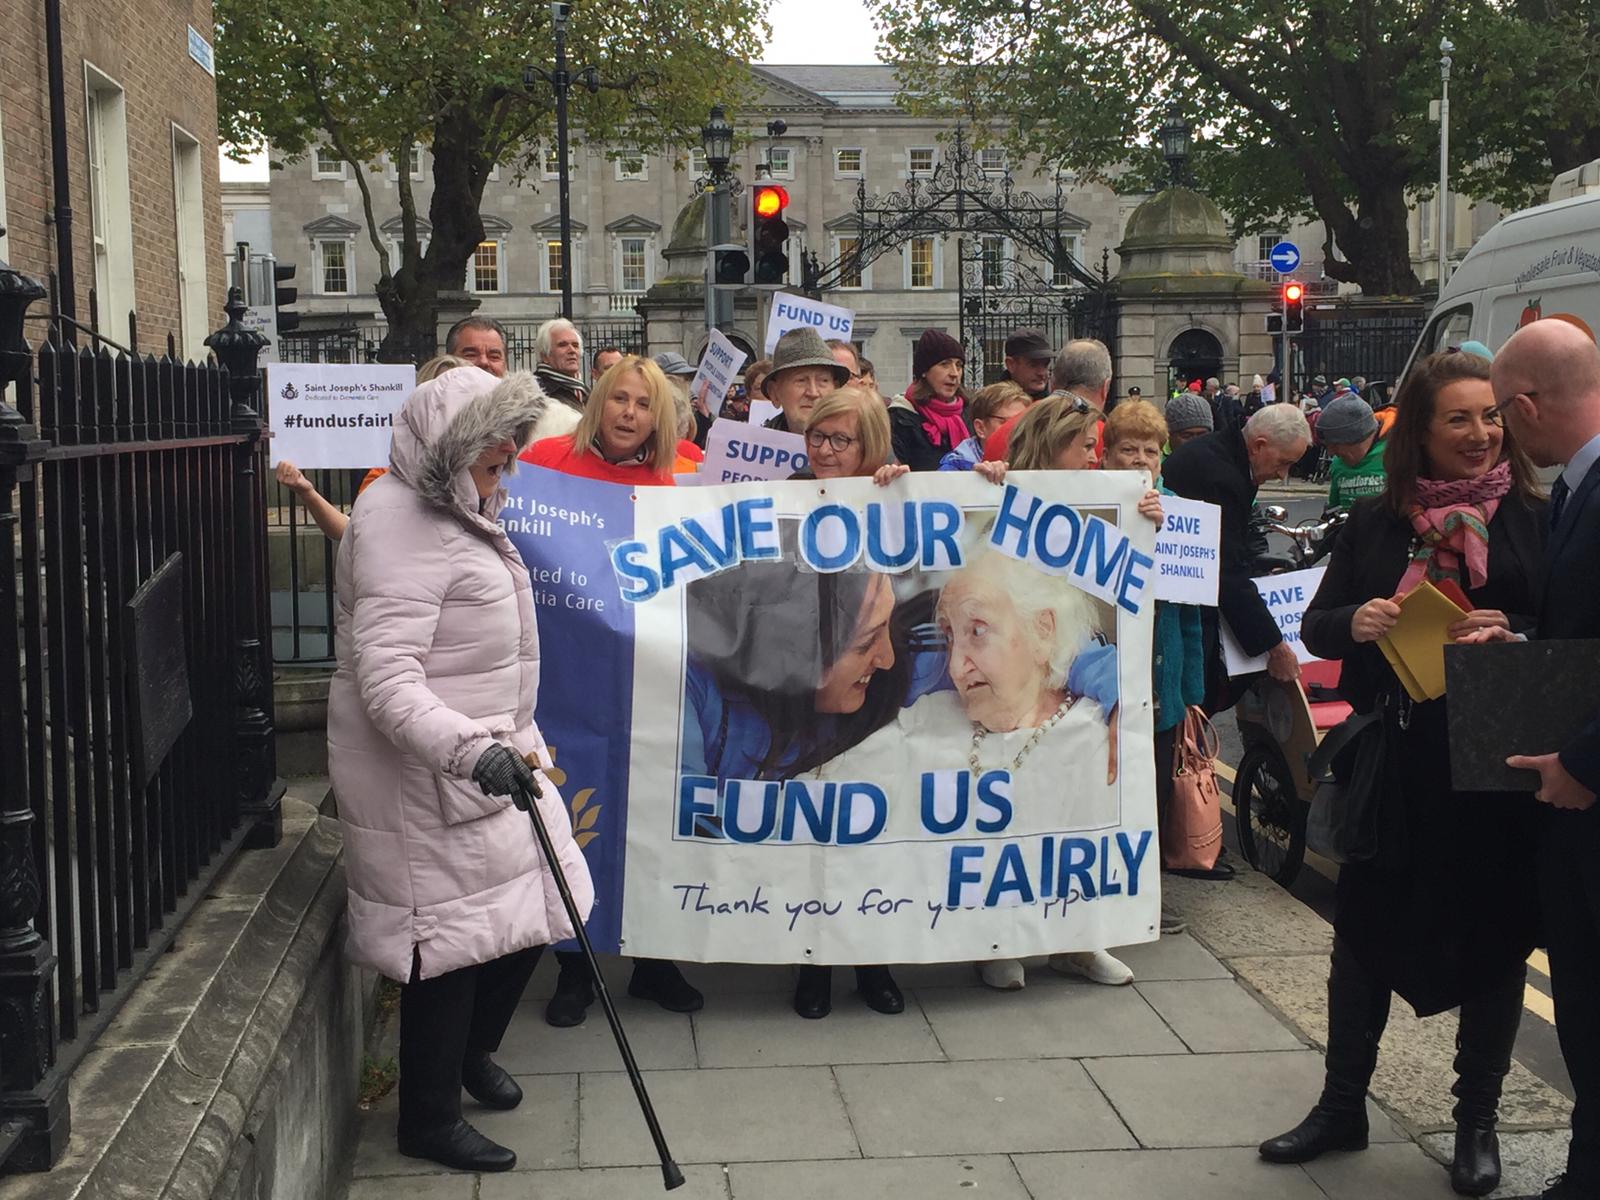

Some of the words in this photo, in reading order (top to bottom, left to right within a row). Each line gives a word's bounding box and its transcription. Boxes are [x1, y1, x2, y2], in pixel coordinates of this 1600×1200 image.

[1514, 256, 1551, 292] Wholesale
[1551, 249, 1568, 267] Fruit
[777, 303, 824, 326] FUND
[829, 315, 850, 333] US
[304, 383, 327, 393] Saint
[329, 384, 367, 393] Joseph's
[369, 383, 403, 392] Shankill
[284, 413, 393, 428] #fundusfairl
[726, 440, 808, 472] SUPPO
[496, 516, 552, 537] ankill
[530, 499, 605, 529] Joseph's
[1167, 514, 1200, 535] SAVE
[613, 497, 774, 601] SAVE
[804, 502, 960, 567] OUR
[991, 485, 1154, 614] HOME
[1154, 542, 1178, 556] AINT
[1179, 544, 1216, 560] JOSEPH'S
[571, 571, 588, 586] to
[1160, 563, 1204, 579] SHANKILL
[565, 593, 605, 611] Care
[679, 775, 887, 844] FUND
[921, 771, 1013, 834] US
[947, 831, 1152, 907] FAIRLY
[673, 882, 769, 914] Thank
[785, 900, 842, 931] you
[857, 888, 913, 915] for
